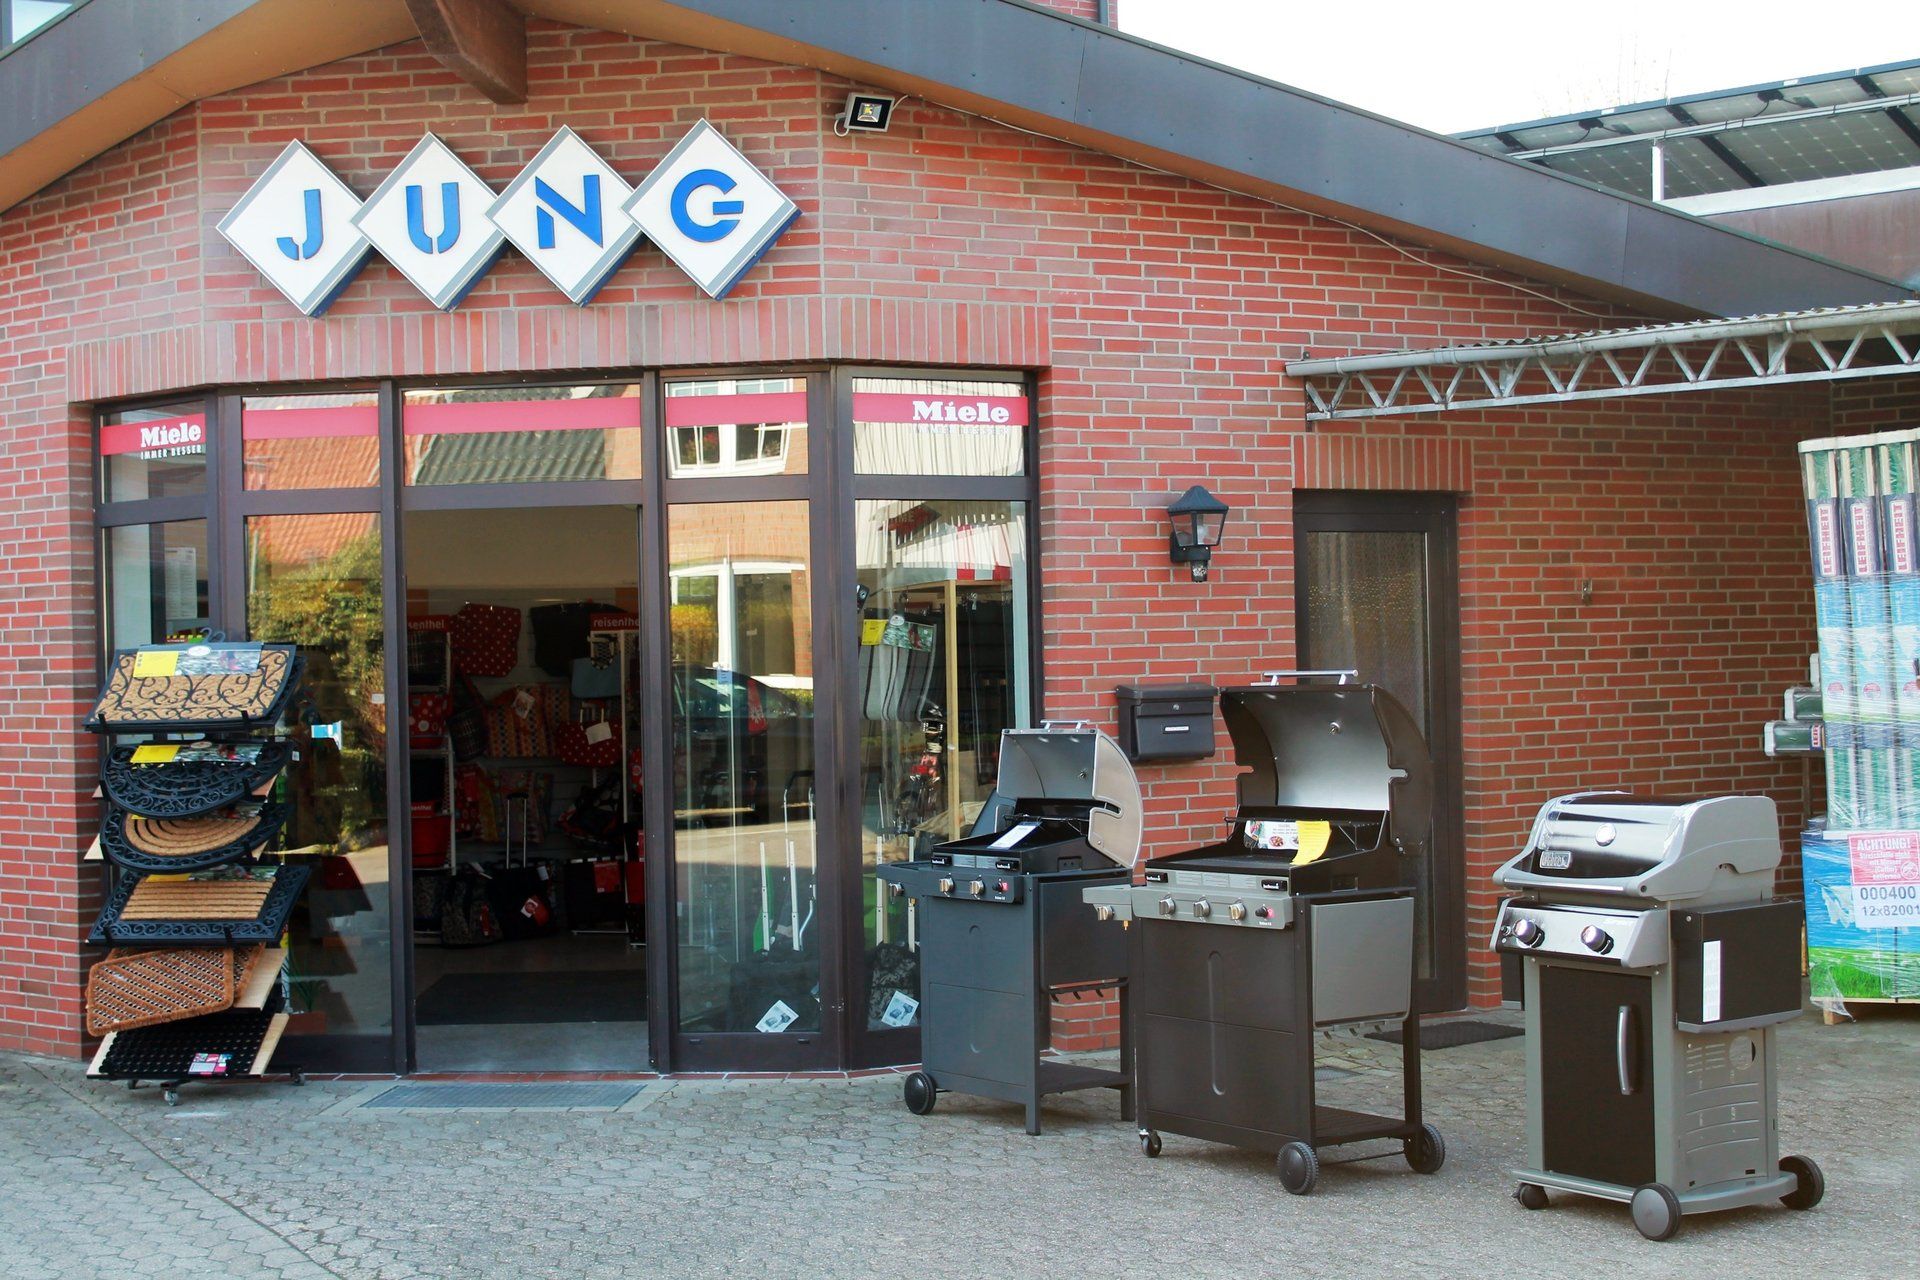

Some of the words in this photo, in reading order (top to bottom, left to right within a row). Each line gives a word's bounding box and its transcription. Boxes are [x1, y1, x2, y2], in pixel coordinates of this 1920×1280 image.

[275, 167, 745, 261] JUNG
[912, 400, 1010, 423] Miele
[140, 422, 201, 447] Miele
[140, 449, 168, 460] IMMER
[171, 444, 202, 456] BESSER
[1819, 507, 1833, 574] LEIFHEIT
[1854, 506, 1868, 573] LEIFHEIT
[1893, 503, 1908, 572] LEIFHEIT
[407, 618, 445, 630] senthel
[593, 616, 639, 628] reisenthe
[1857, 838, 1911, 851] ACHTUNG!
[1860, 886, 1916, 900] 000400
